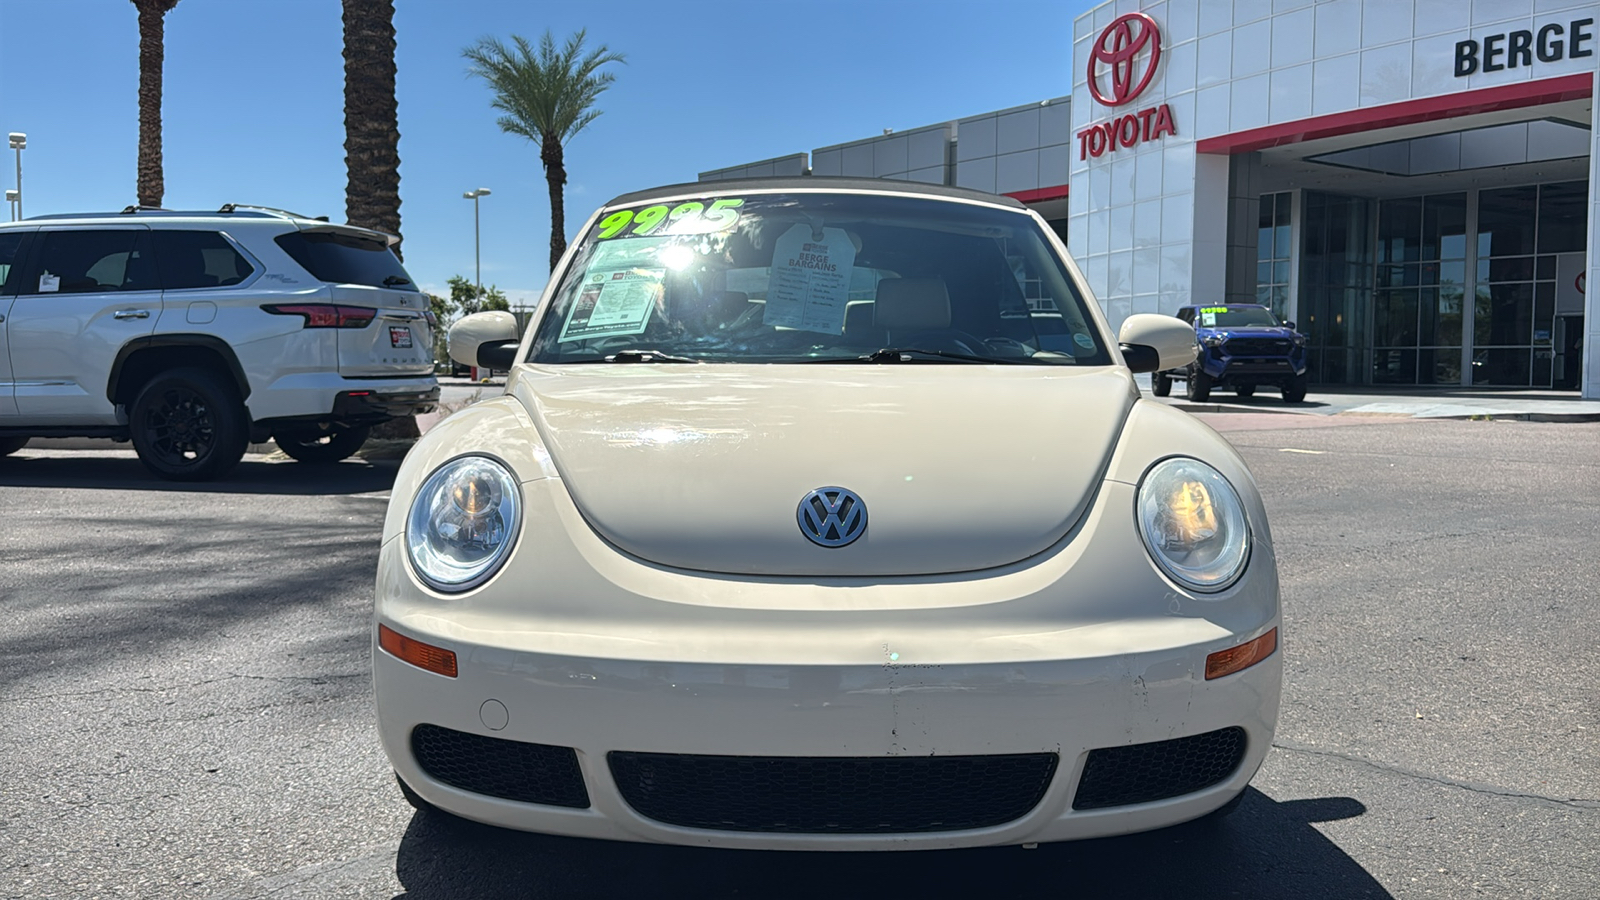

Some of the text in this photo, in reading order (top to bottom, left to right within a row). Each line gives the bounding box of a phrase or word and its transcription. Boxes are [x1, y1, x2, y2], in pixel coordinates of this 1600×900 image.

[1454, 18, 1594, 77] BERGE
[1077, 103, 1176, 161] TOYOTA
[598, 198, 745, 239] 9995
[788, 258, 837, 272] BARGAINS
[799, 252, 830, 264] BERGE
[800, 488, 865, 546] VW
